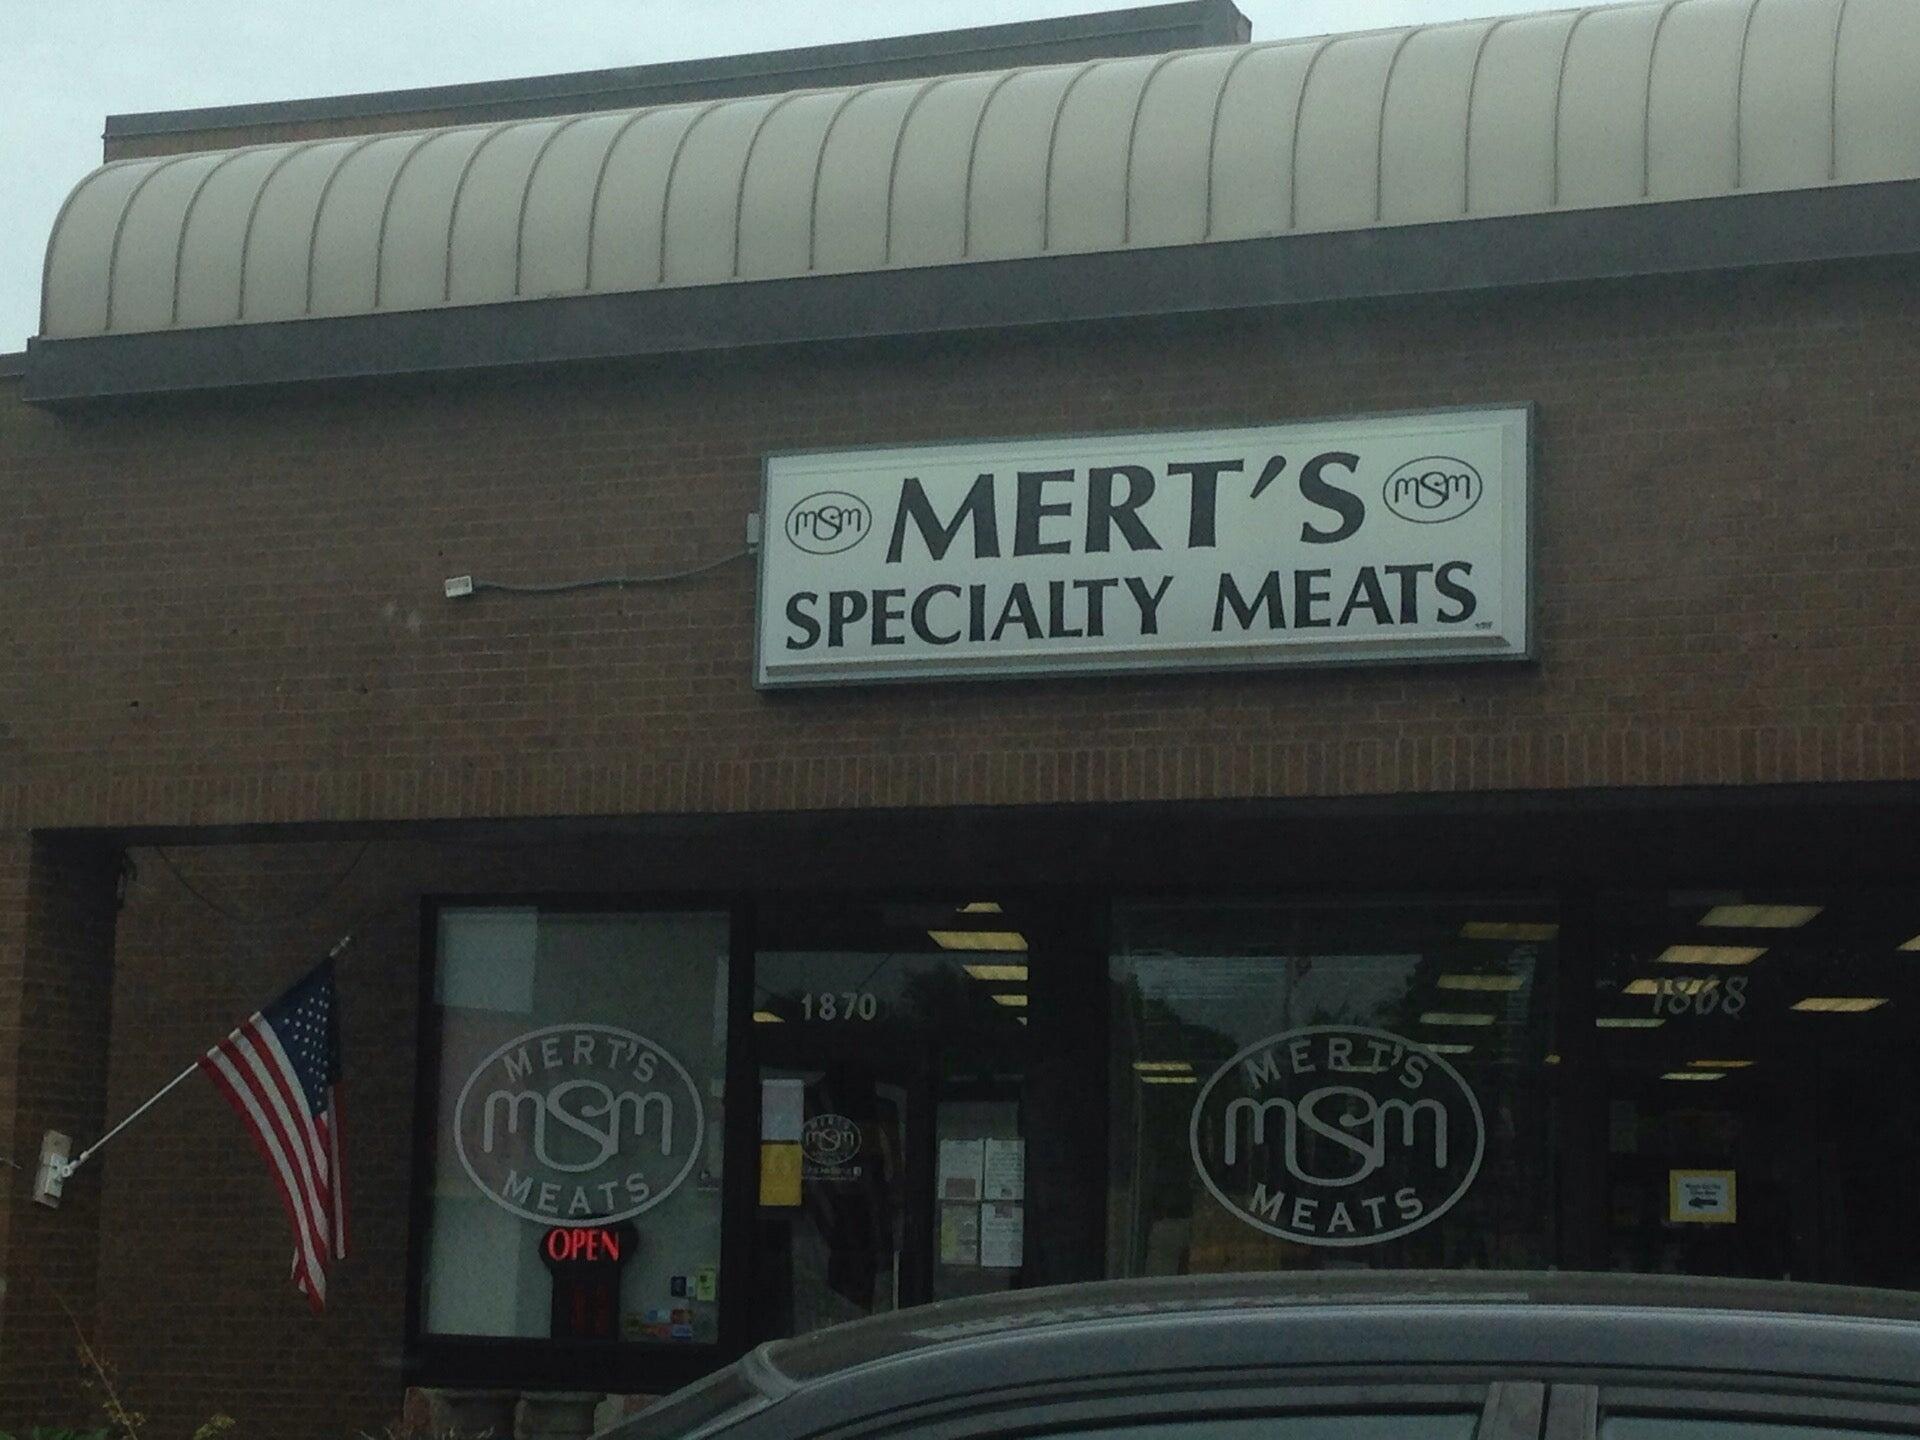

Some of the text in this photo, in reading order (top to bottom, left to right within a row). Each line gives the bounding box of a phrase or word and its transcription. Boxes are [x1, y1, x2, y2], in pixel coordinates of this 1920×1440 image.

[884, 452, 1366, 564] MERT'S
[785, 561, 1479, 650] SPECIALTY MEATS
[801, 992, 877, 1020] 1870
[503, 1035, 658, 1083] MERT'S
[1245, 1038, 1430, 1090] MERT'S
[502, 1169, 649, 1215] MEATS
[1250, 1183, 1423, 1233] MEATS
[548, 1228, 620, 1261] OPEN
